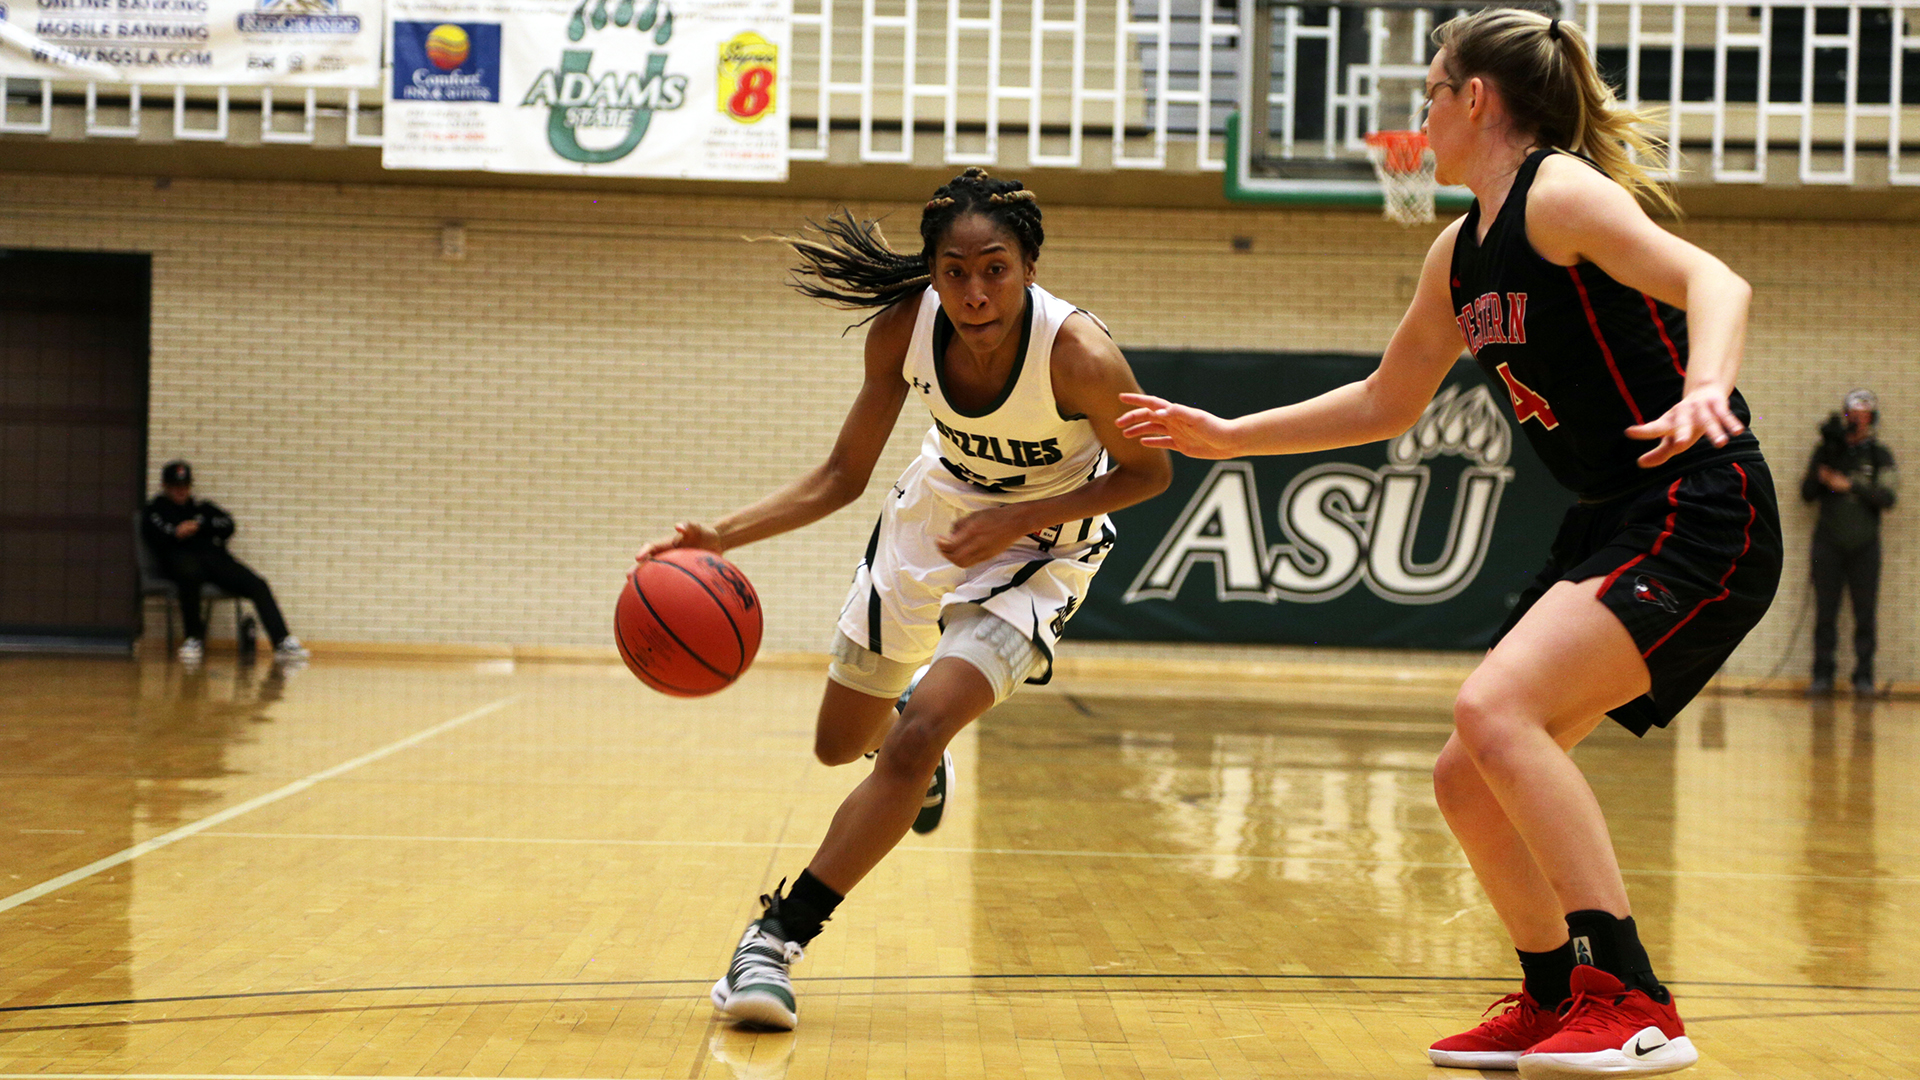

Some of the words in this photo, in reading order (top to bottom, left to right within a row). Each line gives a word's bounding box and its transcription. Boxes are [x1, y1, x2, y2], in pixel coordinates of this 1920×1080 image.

[36, 22, 111, 37] MOBILE
[117, 23, 210, 40] BANKING
[412, 68, 485, 88] Comfort
[518, 69, 689, 110] ADAMS
[730, 68, 773, 117] 8
[563, 107, 635, 128] STATE
[1496, 362, 1560, 431] 4
[930, 410, 1063, 467] RIZZLIES
[1123, 460, 1515, 604] ASU
